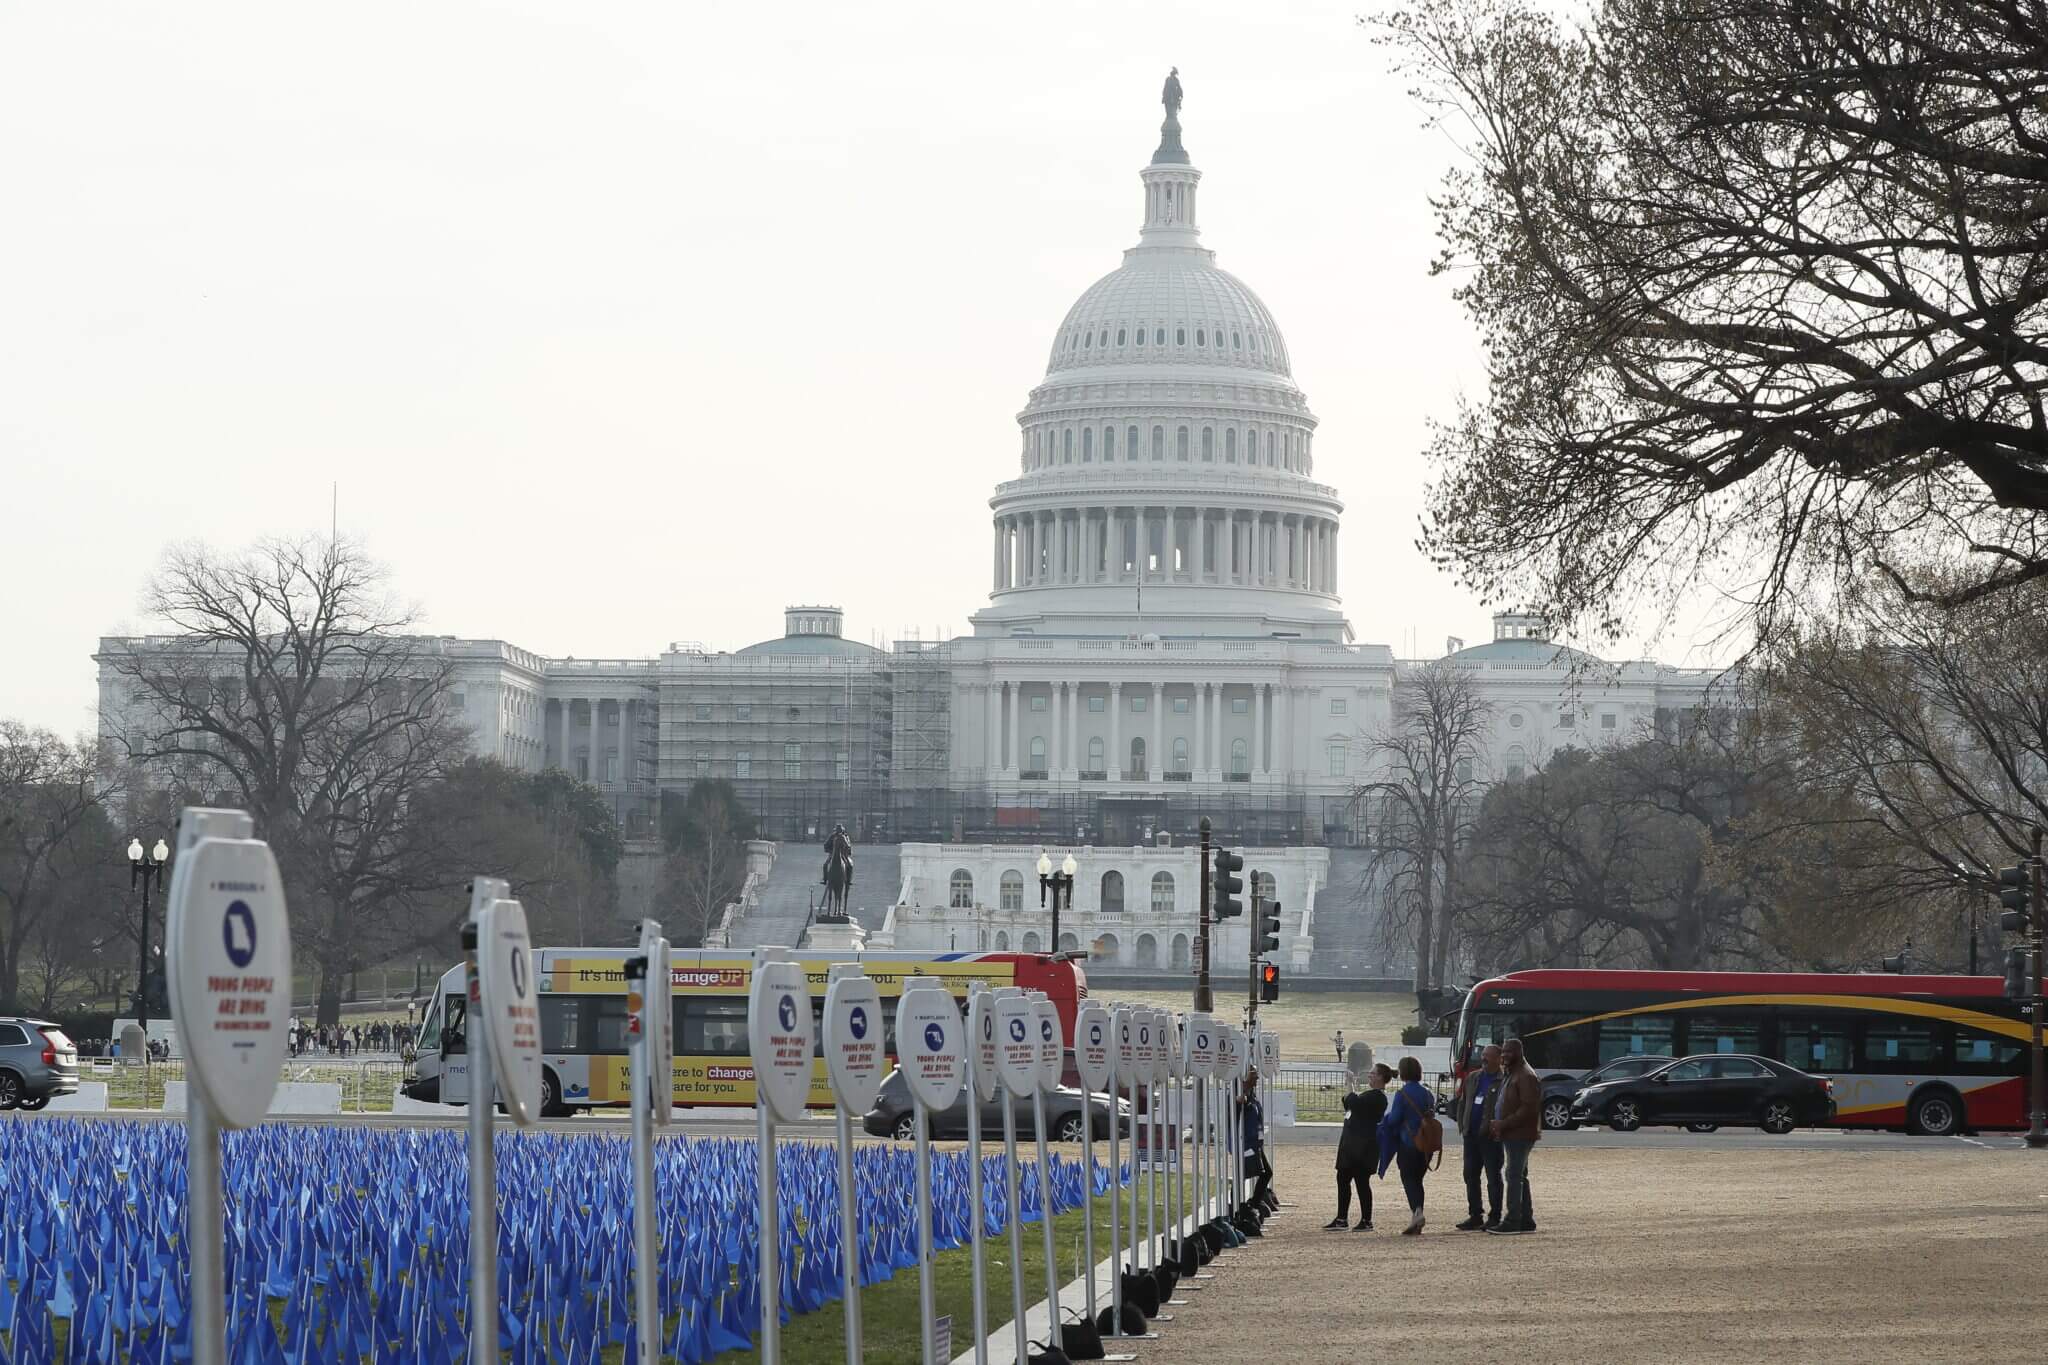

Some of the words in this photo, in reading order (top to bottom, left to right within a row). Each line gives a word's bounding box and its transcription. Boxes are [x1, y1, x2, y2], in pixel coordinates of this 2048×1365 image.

[580, 970, 601, 982] It's
[670, 969, 743, 986] hangeUP
[207, 975, 239, 993] YOUNG
[241, 975, 274, 993] PEOPLE
[2021, 1006, 2034, 1014] 201
[842, 1043, 858, 1052] YOUNG
[859, 1043, 876, 1051] PEOPLE
[916, 1055, 935, 1063] YOUNG
[692, 1066, 703, 1077] to
[708, 1066, 754, 1080] change
[923, 1064, 934, 1072] ARE
[935, 1064, 951, 1072] DYING
[695, 1081, 711, 1092] for
[713, 1083, 737, 1094] you.
